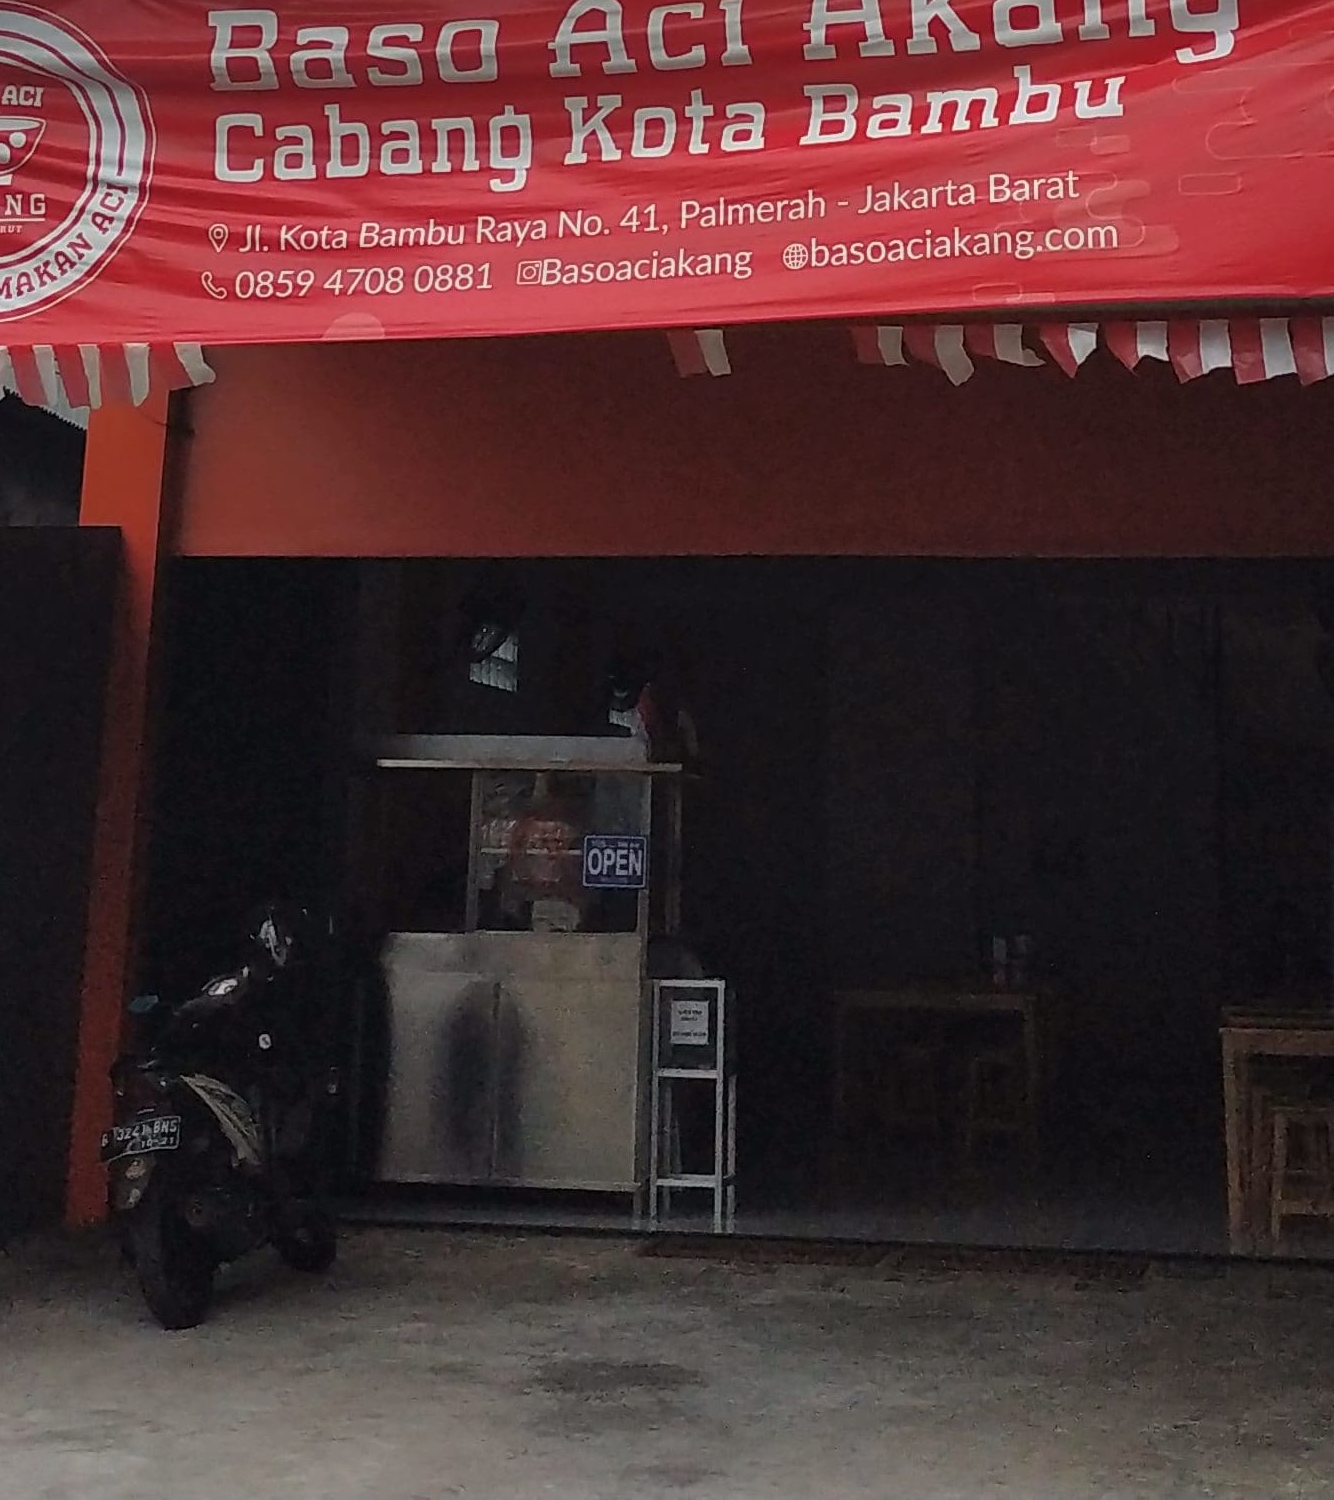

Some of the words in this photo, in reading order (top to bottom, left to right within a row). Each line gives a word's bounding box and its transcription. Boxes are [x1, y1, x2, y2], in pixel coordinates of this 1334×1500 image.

[208, 9, 500, 91] Baso
[0, 85, 45, 109] ACI
[214, 103, 533, 193] Cabang
[563, 88, 766, 166] Kota
[799, 65, 1126, 145] Bambu
[91, 184, 130, 236] ACI
[238, 223, 269, 253] Jl.
[279, 223, 348, 252] Kota
[359, 218, 466, 249] Bambu
[475, 215, 548, 249] Raya
[557, 209, 611, 239] No.
[618, 202, 670, 235] 41,
[680, 190, 827, 229] Palmerah
[857, 178, 976, 216] Jakarta
[988, 169, 1080, 204] Barat
[234, 269, 315, 300] 0859
[323, 265, 405, 296] 4708
[412, 261, 494, 294] 0881
[540, 247, 753, 287] Basoaciakang
[810, 223, 1120, 268] basoaciakang.com
[587, 847, 643, 877] OPEN
